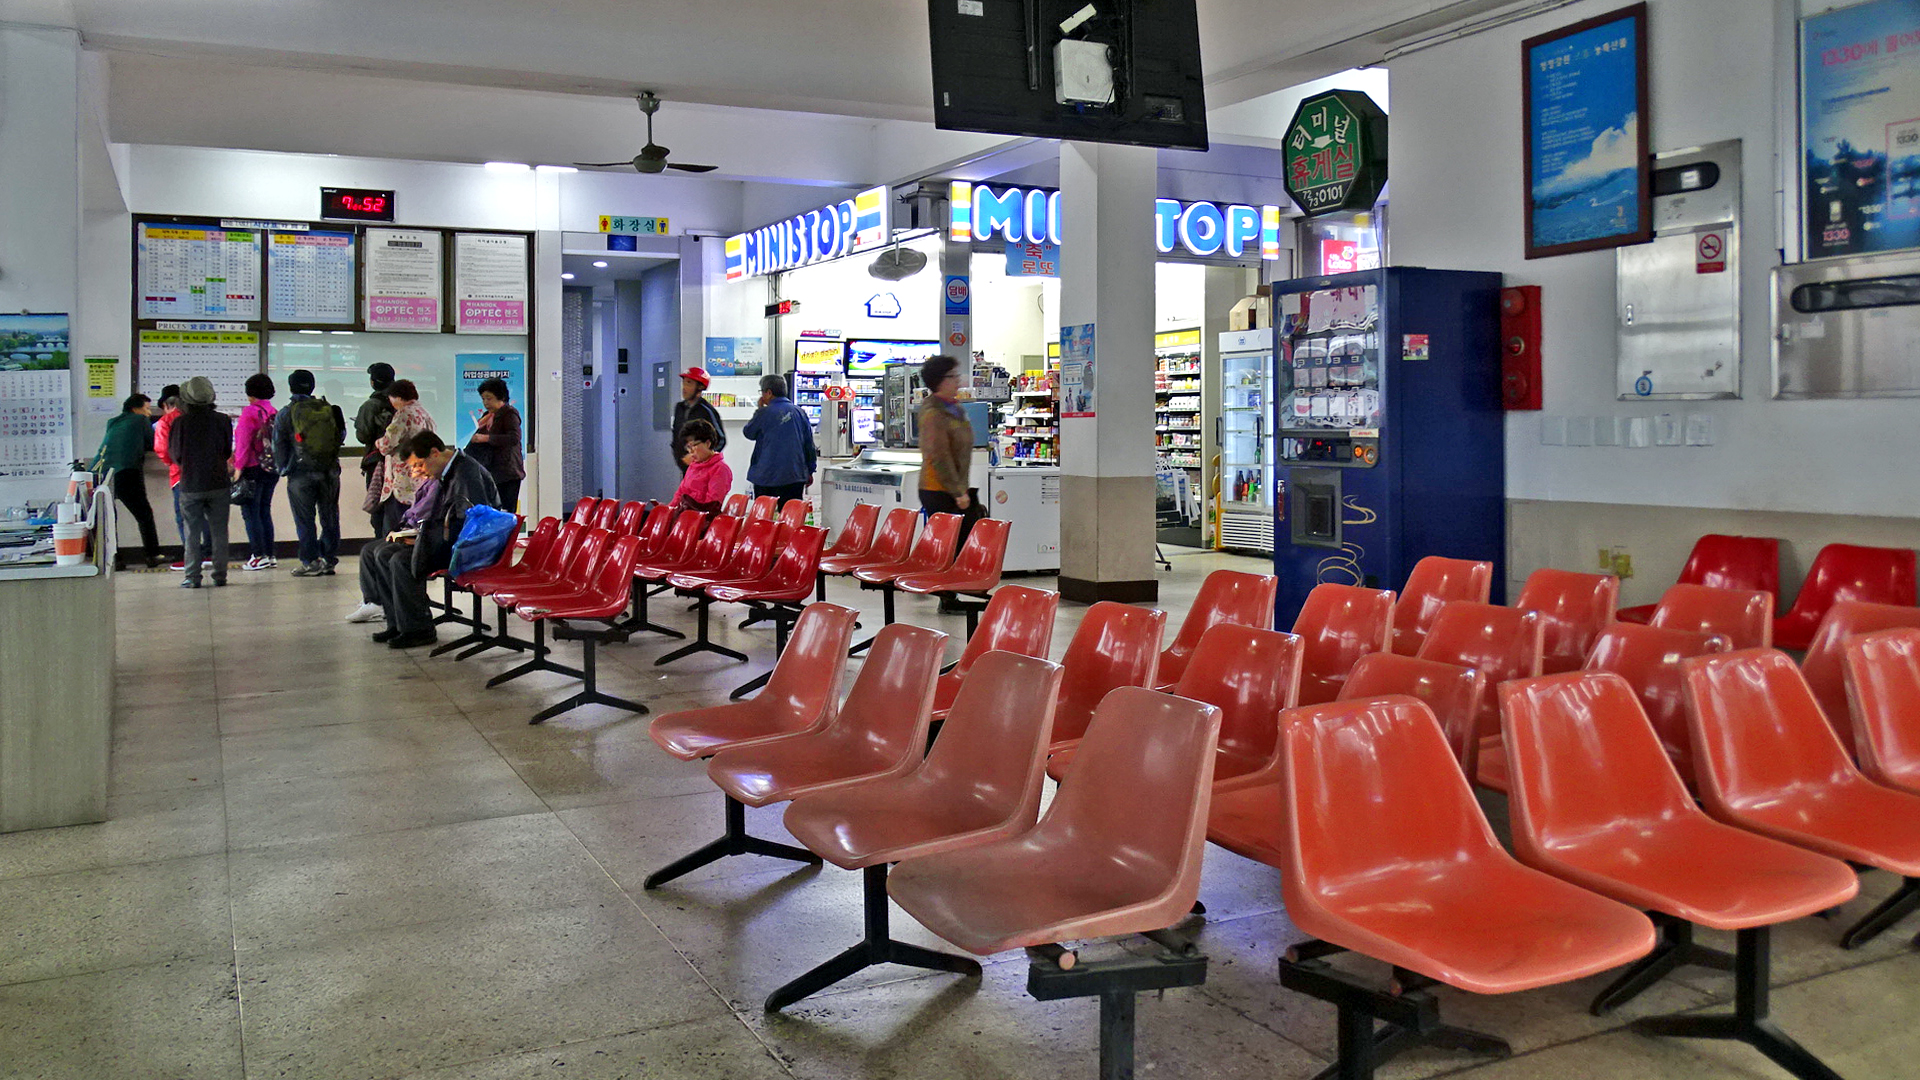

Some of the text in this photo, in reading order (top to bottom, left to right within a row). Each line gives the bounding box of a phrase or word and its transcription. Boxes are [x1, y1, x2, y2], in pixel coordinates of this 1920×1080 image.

[1291, 106, 1350, 150] 터미널
[1291, 143, 1354, 189] 휴게실
[745, 199, 858, 279] MINISTOP
[1022, 260, 1054, 275] 로또
[949, 285, 967, 296] 담배
[375, 305, 413, 315] OPTEC
[465, 308, 502, 317] OPTEC
[158, 322, 187, 330] PRICES
